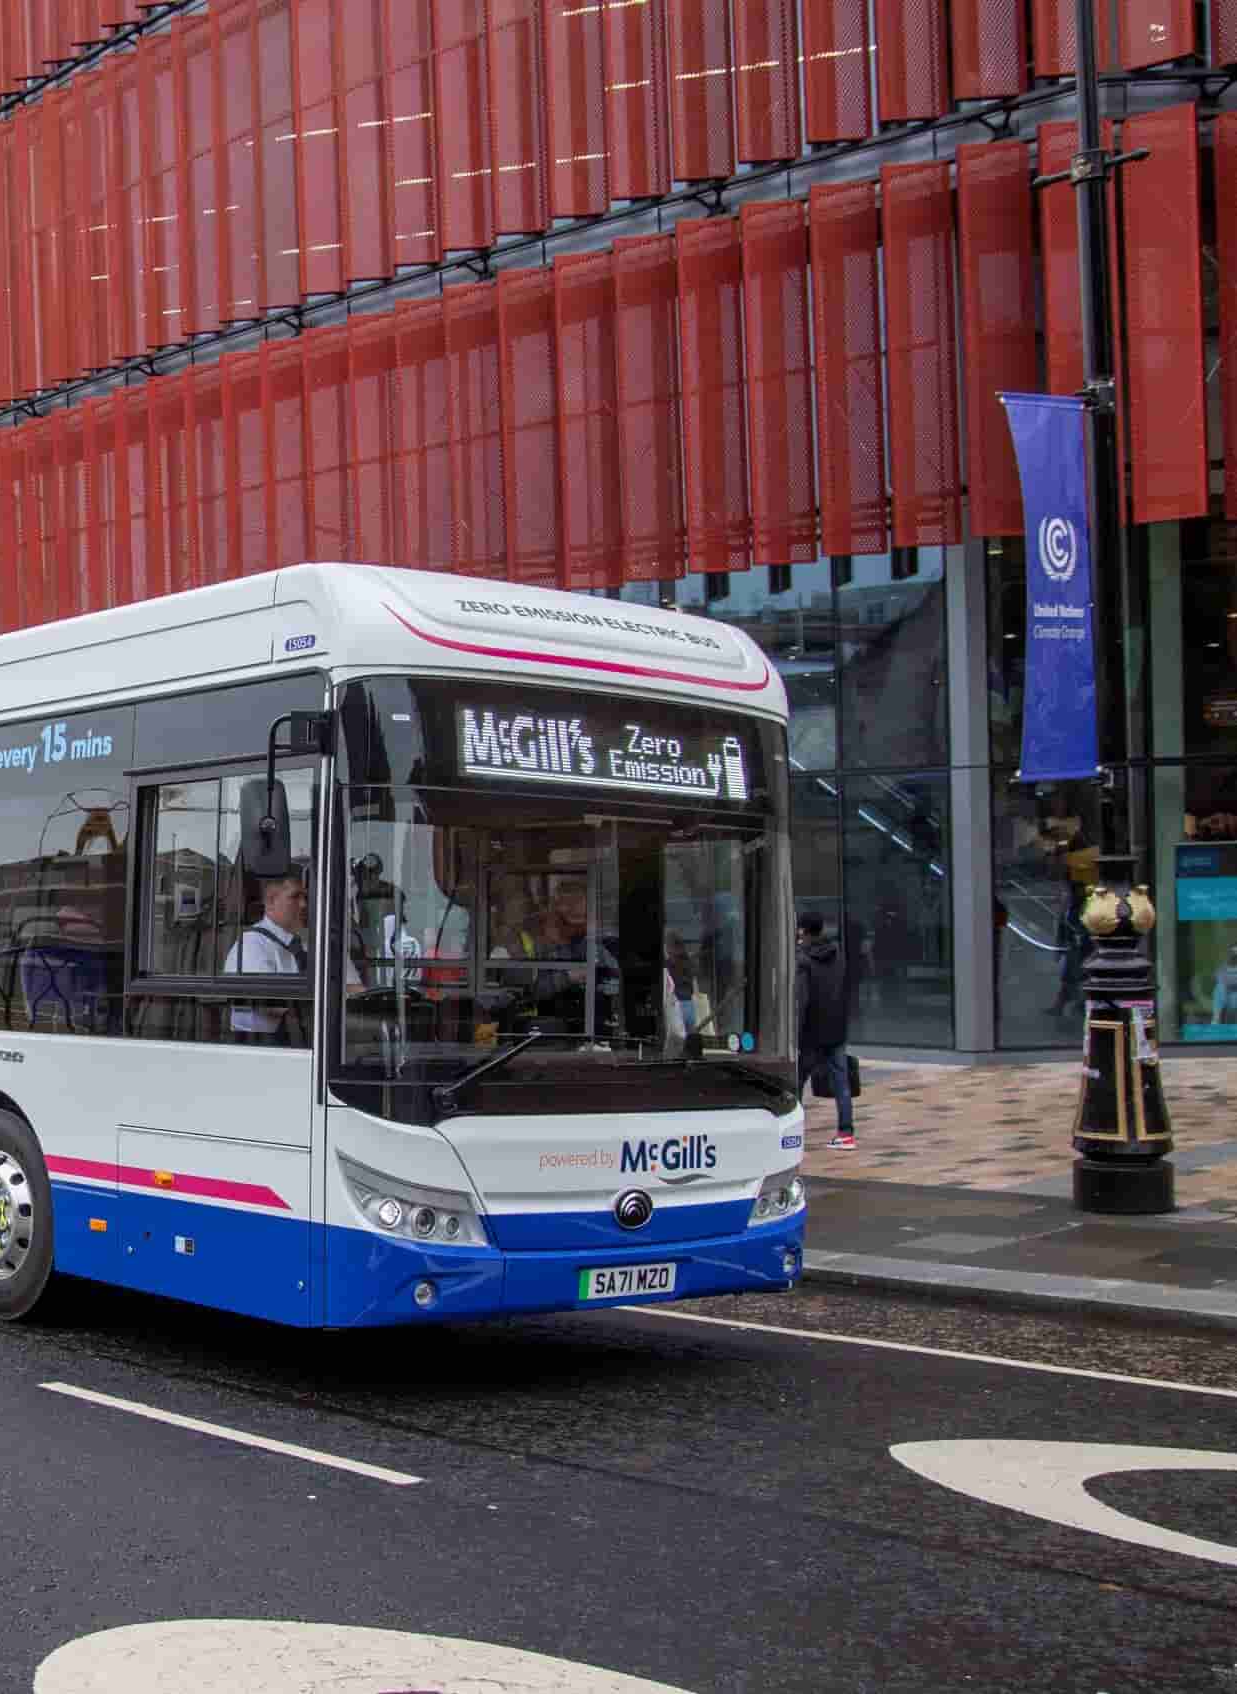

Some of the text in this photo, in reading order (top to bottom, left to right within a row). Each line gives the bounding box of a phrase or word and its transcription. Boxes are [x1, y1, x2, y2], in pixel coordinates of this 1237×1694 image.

[454, 599, 721, 649] ZERO EMISSION ELECTRIC BUS
[41, 722, 67, 763] 15
[71, 729, 113, 760] mins
[463, 708, 681, 774] McGill's Zero
[609, 748, 707, 786] Emission
[539, 1134, 717, 1173] powered by McGill's
[594, 1267, 669, 1295] SA71 MZO
